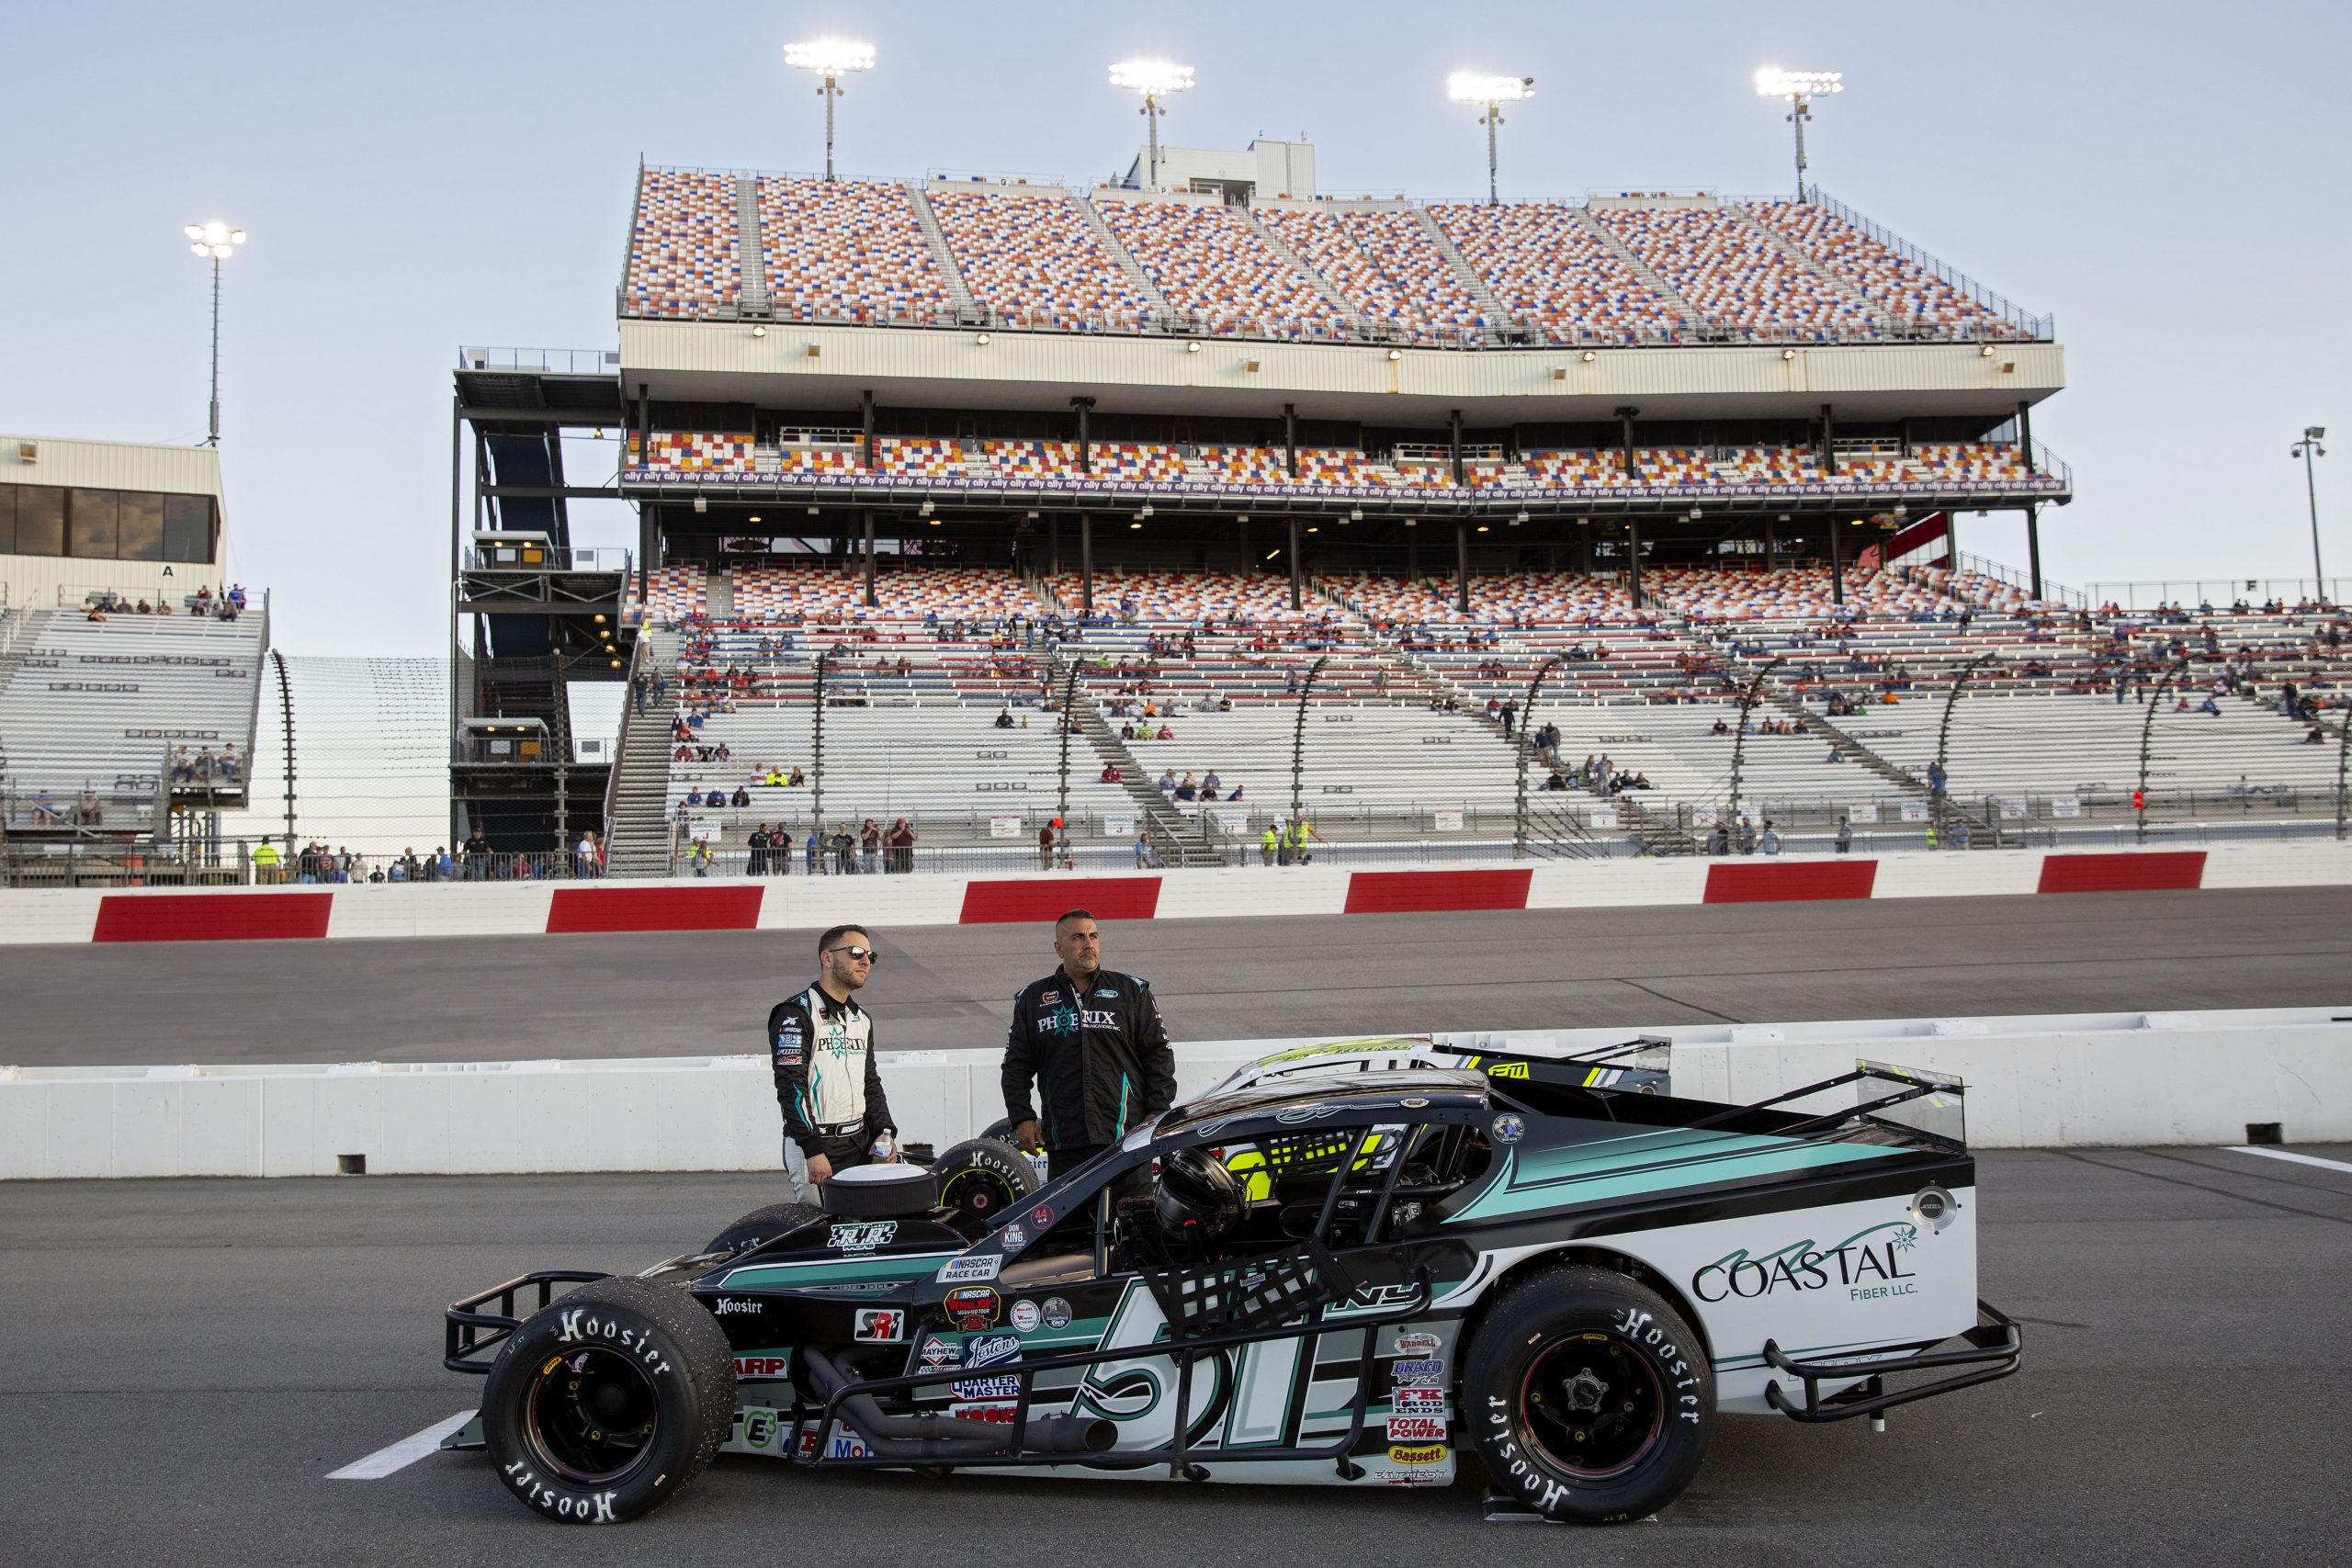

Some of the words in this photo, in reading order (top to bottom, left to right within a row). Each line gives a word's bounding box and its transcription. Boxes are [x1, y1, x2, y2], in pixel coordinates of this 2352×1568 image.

[624, 472, 641, 482] ally
[644, 472, 661, 482] ally
[663, 472, 681, 482] ally
[684, 472, 700, 482] ally
[703, 472, 720, 483] ally
[723, 473, 740, 483] ally
[742, 473, 759, 483] ally
[762, 473, 779, 483] ally
[781, 473, 798, 483] ally
[800, 474, 818, 484] ally
[820, 474, 837, 484] ally
[839, 475, 856, 485] ally
[858, 475, 875, 485] ally
[877, 476, 894, 486] ally
[897, 476, 913, 486] ally
[915, 477, 932, 487] ally
[934, 477, 951, 487] ally
[954, 477, 970, 488] ally
[972, 478, 989, 488] ally
[990, 478, 1007, 489] ally
[1009, 479, 1025, 489] ally
[1028, 479, 1044, 489] ally
[1046, 479, 1062, 490] ally
[1065, 479, 1080, 490] ally
[1083, 480, 1099, 491] ally
[1102, 480, 1117, 491] ally
[1120, 480, 1136, 491] ally
[1137, 481, 1154, 491] ally
[1156, 481, 1171, 491] ally
[1174, 482, 1190, 492] ally
[1192, 482, 1207, 492] ally
[1210, 484, 1226, 494] ally
[1227, 484, 1243, 494] ally
[1245, 484, 1261, 495] ally
[1263, 485, 1279, 495] ally
[1281, 485, 1296, 495] ally
[1298, 485, 1314, 495] ally
[1316, 486, 1331, 496] ally
[1333, 486, 1349, 496] ally
[1351, 486, 1366, 496] ally
[1368, 487, 1384, 497] ally
[1385, 487, 1400, 498] ally
[1403, 488, 1418, 498] ally
[1420, 489, 1435, 499] ally
[1438, 489, 1453, 499] ally
[1455, 490, 1470, 500] ally
[1476, 489, 1490, 499] ally
[1493, 489, 1508, 499] ally
[1510, 488, 1526, 498] ally
[1528, 488, 1544, 498] ally
[1545, 488, 1561, 498] ally
[1563, 487, 1578, 498] ally
[1580, 487, 1596, 497] ally
[1598, 487, 1613, 497] ally
[1615, 487, 1631, 497] ally
[1633, 486, 1648, 496] ally
[1650, 486, 1666, 496] ally
[1668, 486, 1683, 496] ally
[1685, 485, 1701, 496] ally
[1702, 485, 1717, 495] ally
[1720, 485, 1735, 495] ally
[1737, 484, 1752, 495] ally
[1755, 484, 1770, 494] ally
[1771, 484, 1787, 494] ally
[1789, 484, 1804, 494] ally
[1806, 484, 1821, 494] ally
[1824, 484, 1838, 494] ally
[1840, 483, 1855, 493] ally
[1858, 483, 1873, 493] ally
[1875, 482, 1890, 492] ally
[1892, 482, 1907, 492] ally
[1909, 481, 1924, 492] ally
[1927, 481, 1941, 491] ally
[1943, 480, 1958, 491] ally
[1961, 480, 1975, 491] ally
[1977, 480, 1993, 491] ally
[1995, 480, 2009, 491] ally
[2011, 480, 2026, 491] ally
[2029, 480, 2043, 491] ally
[2045, 479, 2060, 490] ally
[163, 566, 174, 577] A
[1037, 1010, 1115, 1033] PHOENIX
[1905, 1087, 1925, 1100] FURY
[969, 1150, 1024, 1191] Hoosier
[1035, 1209, 1047, 1218] 44
[1004, 1231, 1023, 1243] KING
[958, 1258, 993, 1269] NASCAR
[945, 1269, 969, 1279] RACE
[971, 1269, 990, 1277] CAR
[1691, 1242, 1917, 1303] COASTAL
[962, 1289, 990, 1299] NASCAR
[1849, 1288, 1888, 1302] FIBER
[714, 1297, 763, 1316] Hoosier
[558, 1309, 671, 1375] Hoosier
[1399, 1337, 1435, 1348] WADDELL
[922, 1347, 956, 1356] MAYHEW
[965, 1336, 1019, 1369] Jostens
[1615, 1307, 1701, 1425] Hoosier
[951, 1375, 1016, 1393] QUARTER
[964, 1385, 1021, 1399] MASTER
[1398, 1389, 1443, 1400] FK
[1387, 1418, 1438, 1429] TOTAL
[1389, 1428, 1445, 1438] POWER
[1485, 1395, 1570, 1512] Hoosier
[1373, 1469, 1448, 1480] EARNEST
[505, 1461, 617, 1523] Hoosier
